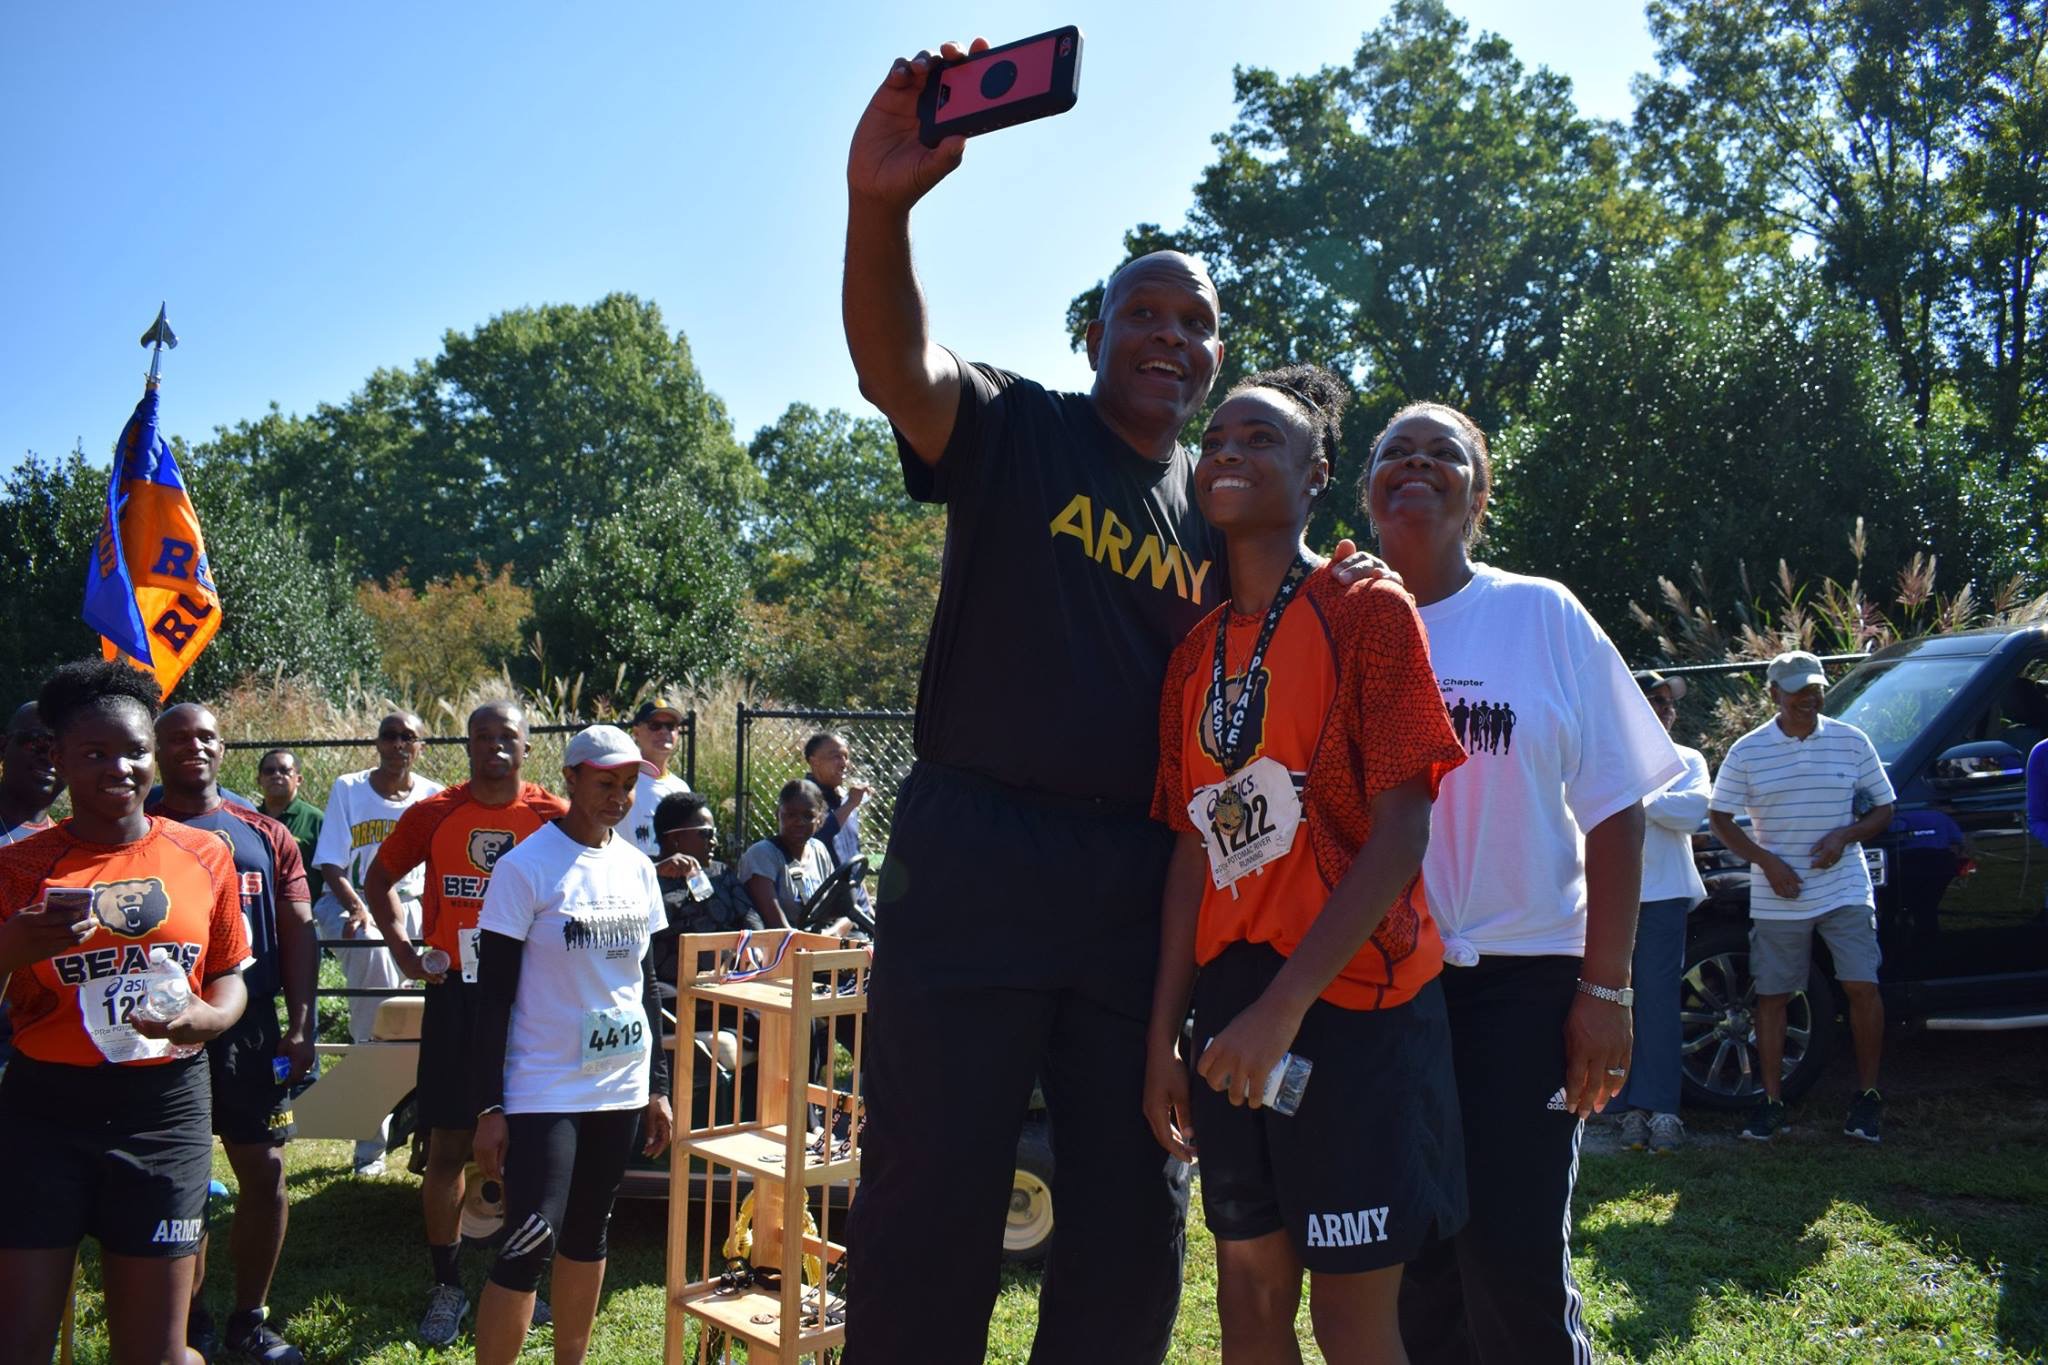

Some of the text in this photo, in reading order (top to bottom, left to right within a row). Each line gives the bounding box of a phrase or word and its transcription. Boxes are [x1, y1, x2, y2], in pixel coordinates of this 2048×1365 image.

[1050, 494, 1212, 606] ARMY
[1213, 665, 1224, 747] FIRST
[1227, 656, 1261, 745] PLACE
[1442, 678, 1484, 687] Chapter
[589, 1020, 643, 1052] 4419
[1307, 1206, 1390, 1247] ARMY
